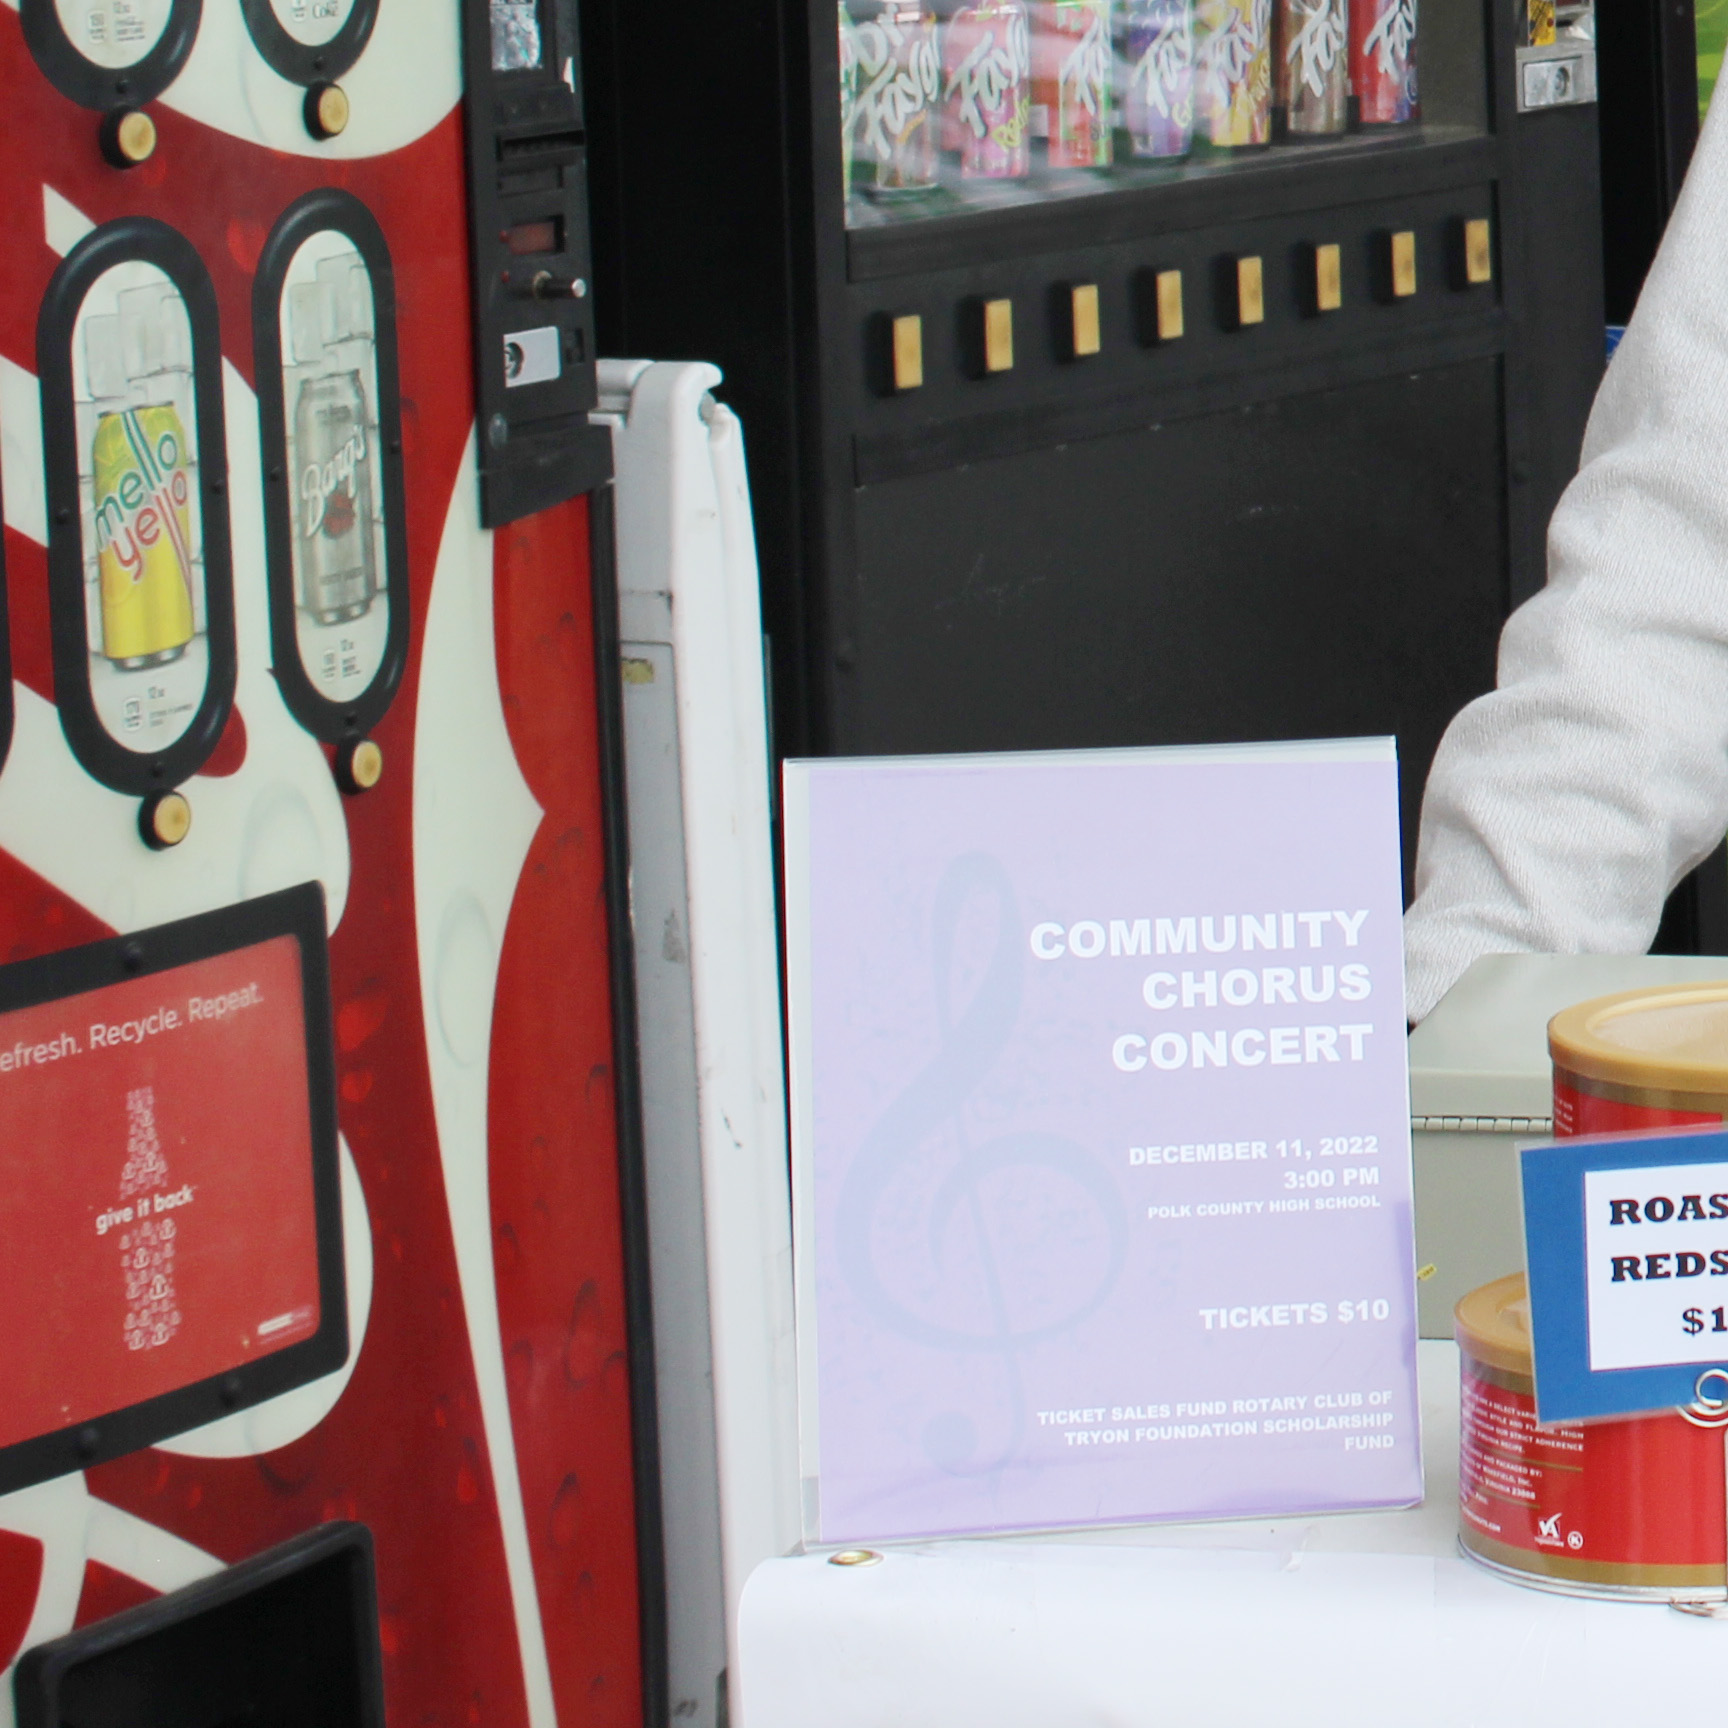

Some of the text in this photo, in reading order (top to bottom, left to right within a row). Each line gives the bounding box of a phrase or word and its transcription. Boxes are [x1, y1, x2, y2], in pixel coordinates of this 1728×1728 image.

[1029, 910, 1370, 959] COMMUNITY
[1142, 964, 1372, 1010] CHORUS
[0, 981, 264, 1072] efresh. Recycle. Repeat.
[1112, 1024, 1374, 1072] CONCERT
[1128, 1136, 1378, 1166] DECEMBER 11, 2022
[1283, 1167, 1379, 1190] 3:00 PM
[95, 1185, 195, 1235] give it back
[1148, 1195, 1381, 1218] POLK COUNTY HIGH SCHOOL
[1199, 1299, 1390, 1330] TICKETS $10
[1037, 1391, 1393, 1425] TICKET SALES FUND ROTARY CLUB OF
[1064, 1412, 1394, 1446] TRYON FOUNDATION SCHOLARSHIP
[1344, 1435, 1395, 1451] FUND
